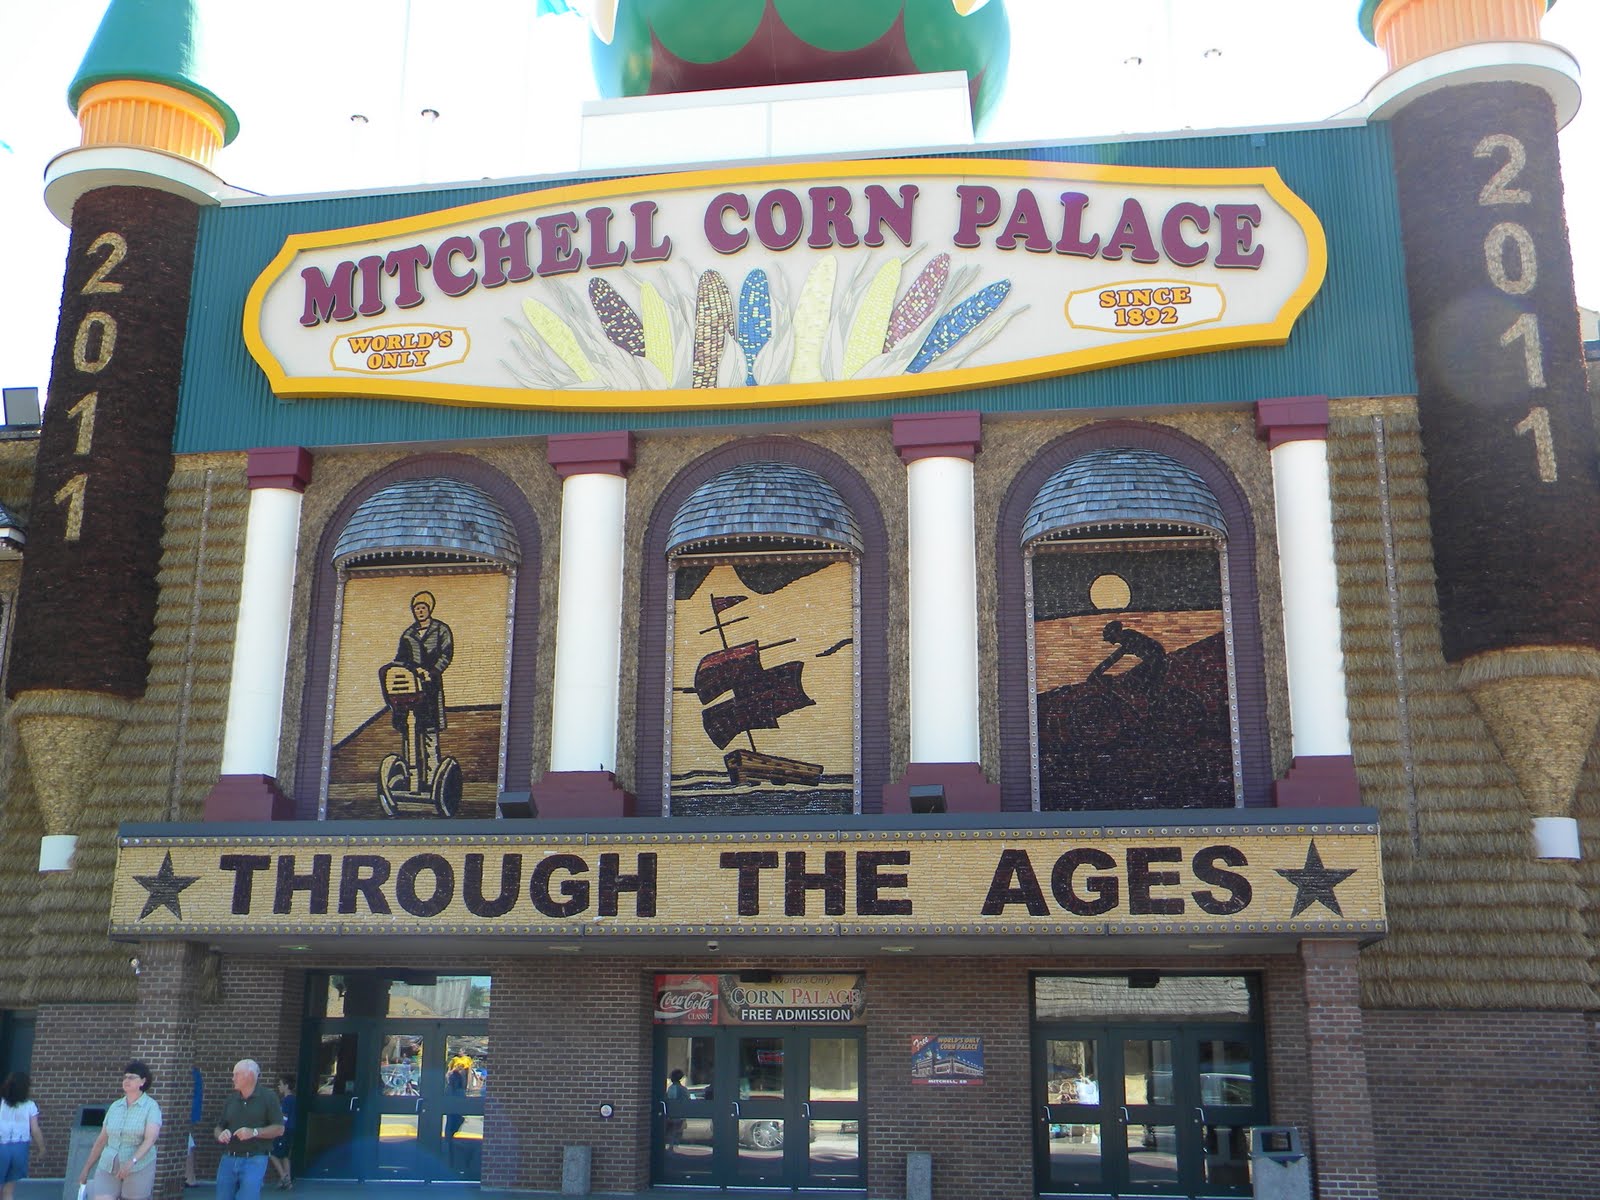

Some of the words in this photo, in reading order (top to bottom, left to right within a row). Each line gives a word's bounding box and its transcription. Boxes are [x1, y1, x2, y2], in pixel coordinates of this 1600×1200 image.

[299, 201, 673, 327] MITCHELL
[703, 184, 919, 254] CORN
[956, 185, 1265, 270] PALACE
[1099, 287, 1191, 308] SINCE
[1473, 133, 1558, 483] 2011
[1114, 306, 1178, 326] 1892
[348, 331, 452, 353] WORLD'S
[367, 350, 430, 369] ONLY
[53, 231, 129, 542] 2011
[219, 852, 658, 919] THROUGH
[719, 850, 912, 917] THE
[980, 845, 1252, 917] AGES
[775, 976, 808, 984] World's
[731, 987, 785, 1005] CORN
[791, 988, 860, 1006] PALACE
[741, 1009, 772, 1021] FREE
[775, 1009, 850, 1021] ADMISSION
